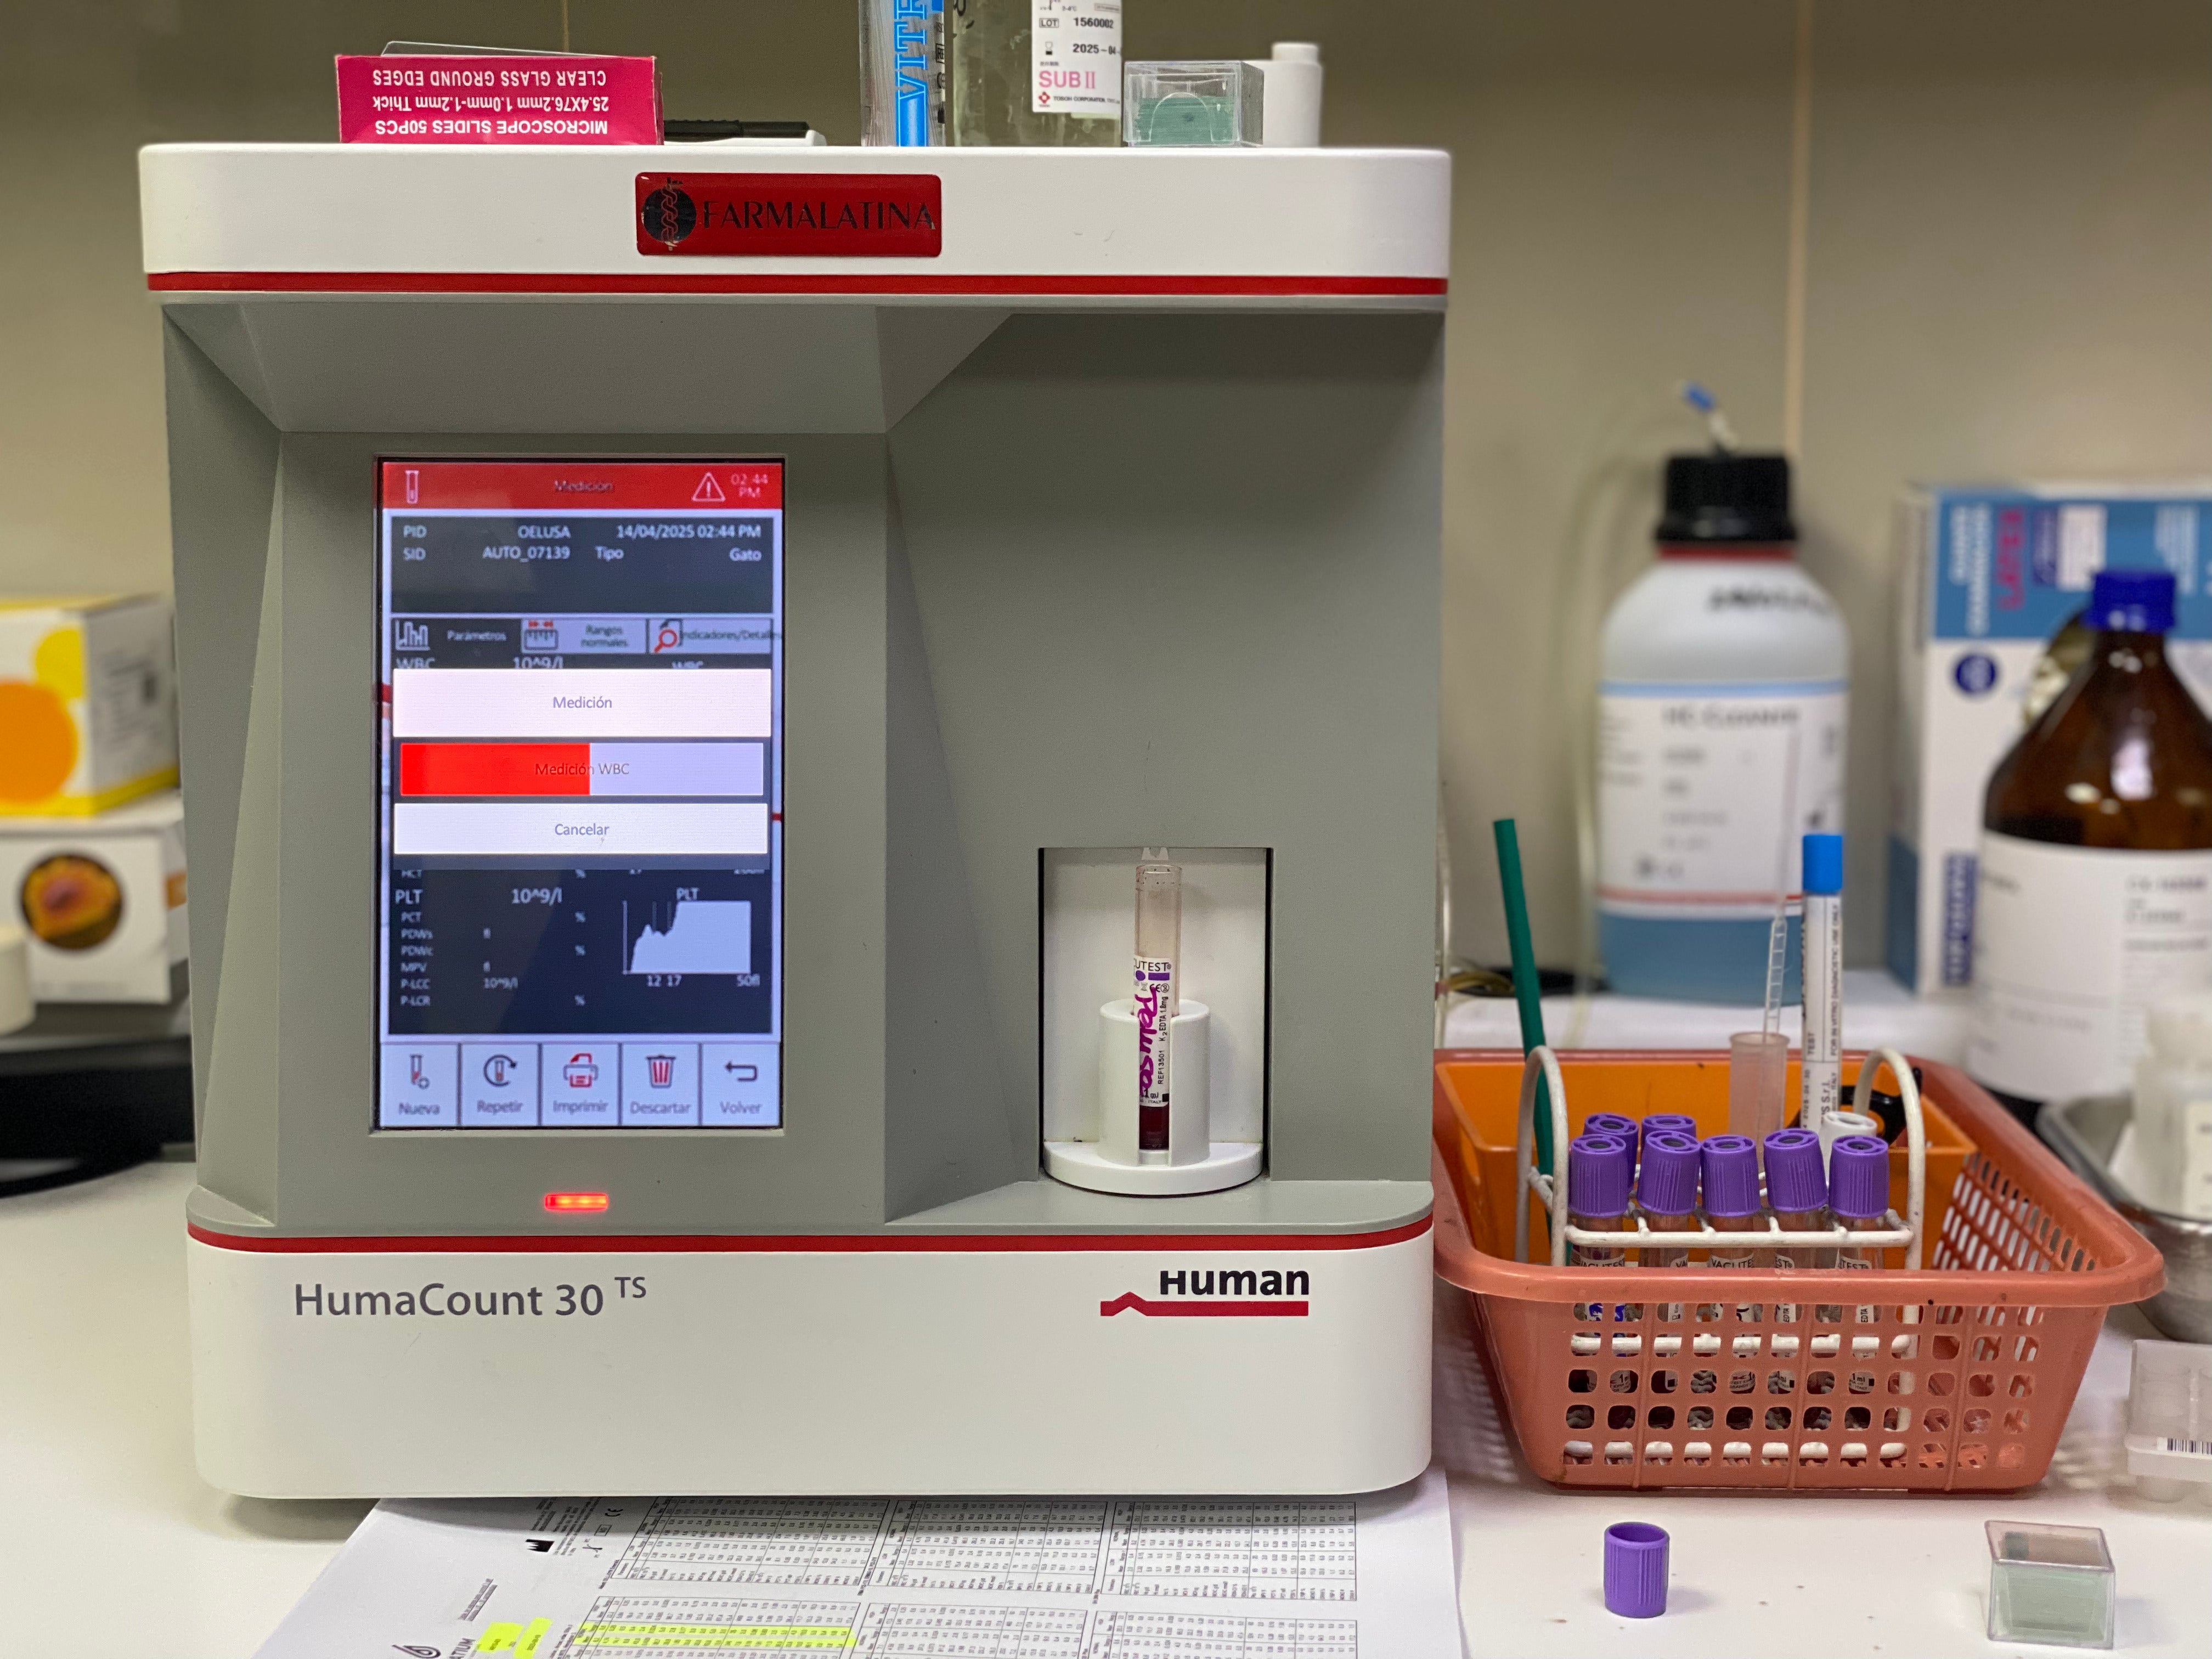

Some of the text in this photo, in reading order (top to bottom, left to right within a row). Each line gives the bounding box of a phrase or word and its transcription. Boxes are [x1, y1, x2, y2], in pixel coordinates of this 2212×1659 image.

[1074, 18, 1114, 29] 1560002
[373, 69, 606, 87] CLEAR GLASS GROUND EDGES
[1039, 70, 1081, 88] SUB
[373, 94, 609, 112] 25.4X76.2mm 1.0mm-1.2mm Thick
[375, 120, 608, 134] MICROSCOPE SLIDES 50PCS
[703, 200, 935, 230] FARMALATINA
[403, 525, 426, 539] PID
[617, 524, 695, 540] 14/04/2025
[699, 525, 736, 539] 02:44
[738, 525, 761, 539] PM
[403, 546, 762, 562] SID AUTO_07139 Tipo Gato
[552, 694, 613, 709] Medición
[535, 762, 630, 776] Medición WBC
[554, 822, 610, 837] Cancelar
[395, 889, 422, 905] PLT
[647, 974, 662, 987] 12
[666, 974, 682, 987] 17
[399, 1103, 441, 1116] Nueva
[477, 1100, 523, 1116] Repetir
[553, 1099, 608, 1116] Imprimir
[630, 1101, 691, 1115] Descartar
[719, 1101, 763, 1115] Volver
[1160, 1271, 1310, 1295] Human
[295, 1277, 647, 1316] HumaCount 30 TS
